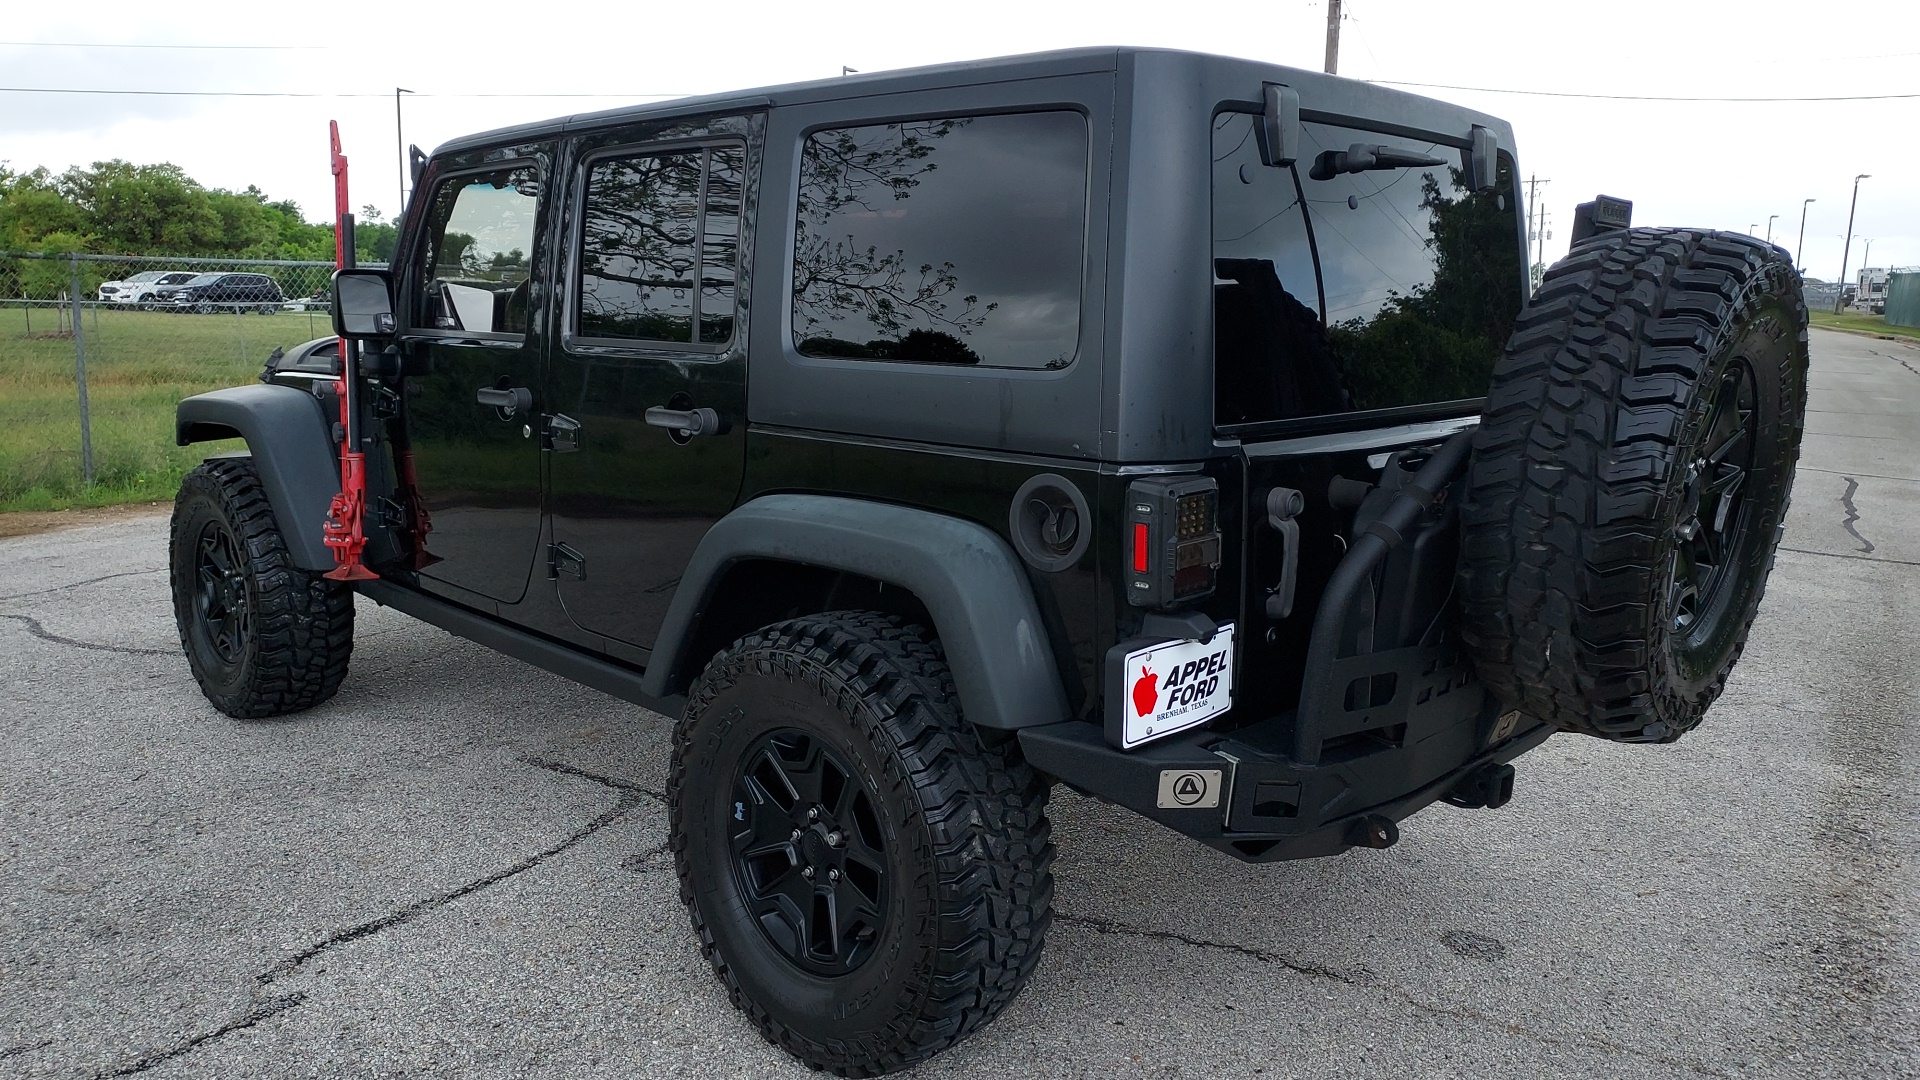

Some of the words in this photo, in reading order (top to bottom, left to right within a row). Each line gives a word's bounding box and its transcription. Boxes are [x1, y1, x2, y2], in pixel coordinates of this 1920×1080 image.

[1163, 649, 1227, 690] APPEL
[1156, 706, 1190, 721] BRENHAM,
[1190, 699, 1209, 711] TEXAS
[1167, 676, 1219, 710] FORD
